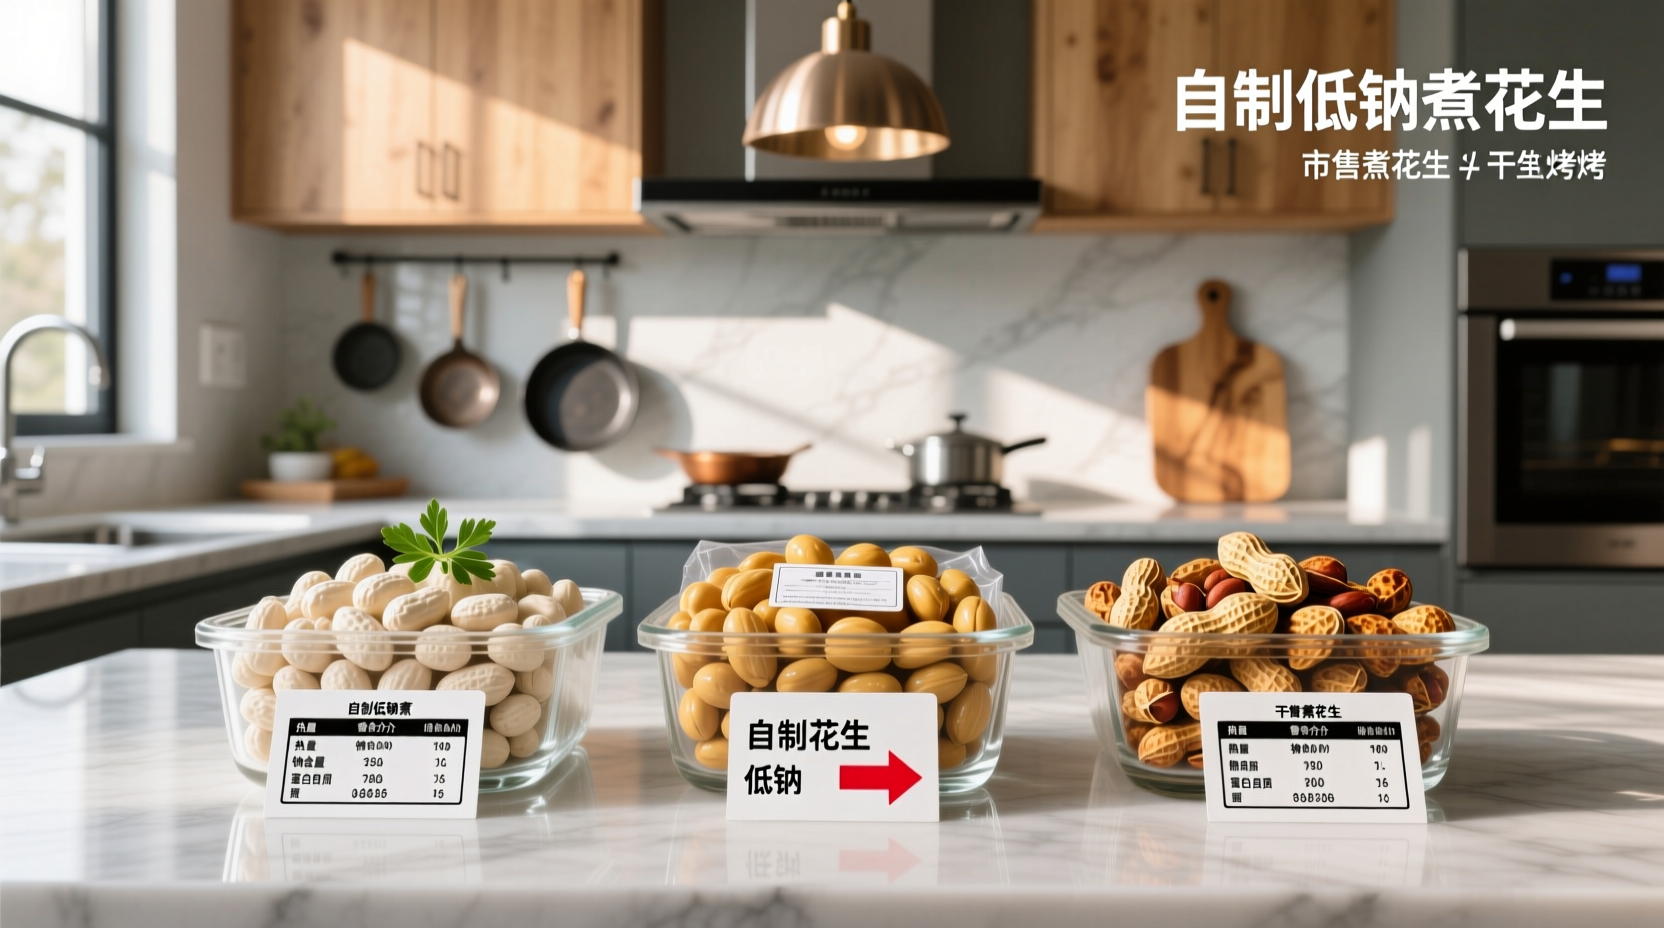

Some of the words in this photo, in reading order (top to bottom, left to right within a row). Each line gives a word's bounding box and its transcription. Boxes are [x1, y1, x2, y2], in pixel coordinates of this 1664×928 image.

[749, 718, 870, 751] 自制花生
[744, 764, 802, 795] 低钠
